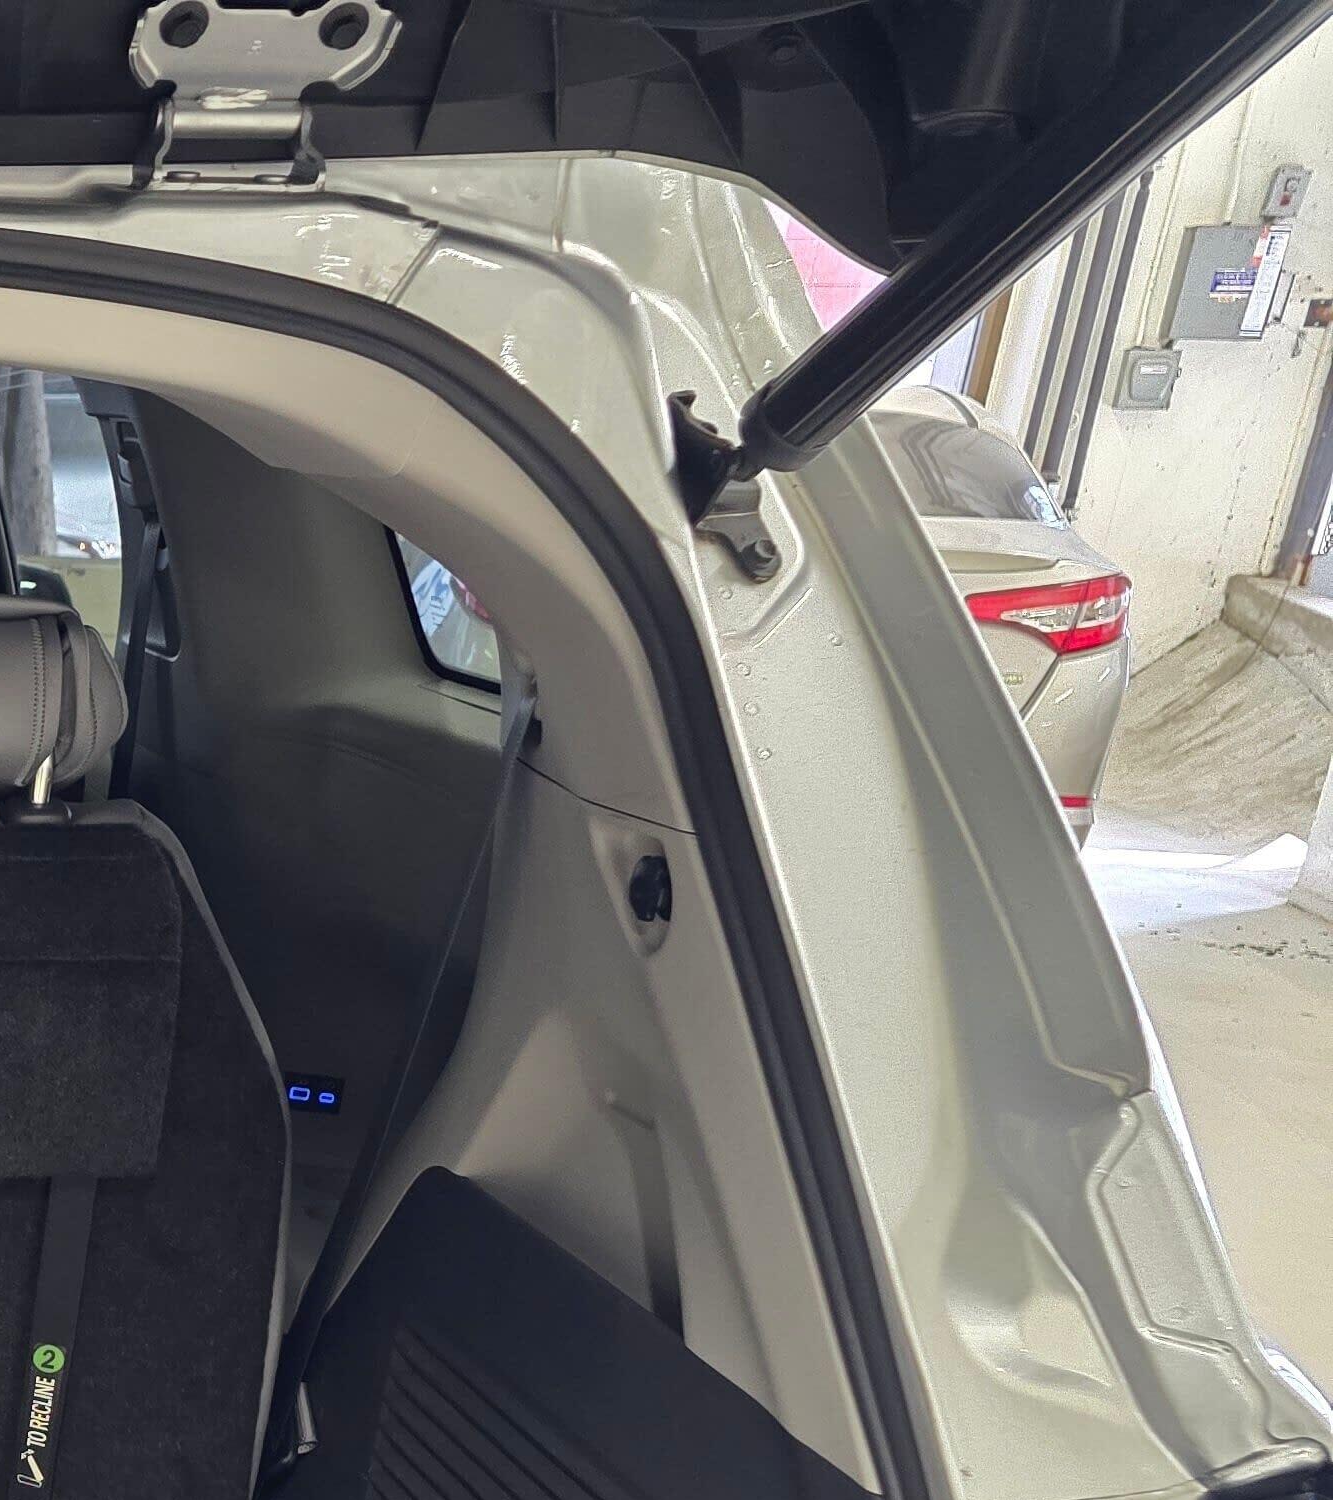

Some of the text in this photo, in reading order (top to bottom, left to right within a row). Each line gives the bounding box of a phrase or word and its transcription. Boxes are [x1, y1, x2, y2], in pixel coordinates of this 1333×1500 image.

[41, 1349, 56, 1369] 2
[26, 1376, 55, 1447] TO RECLINE
